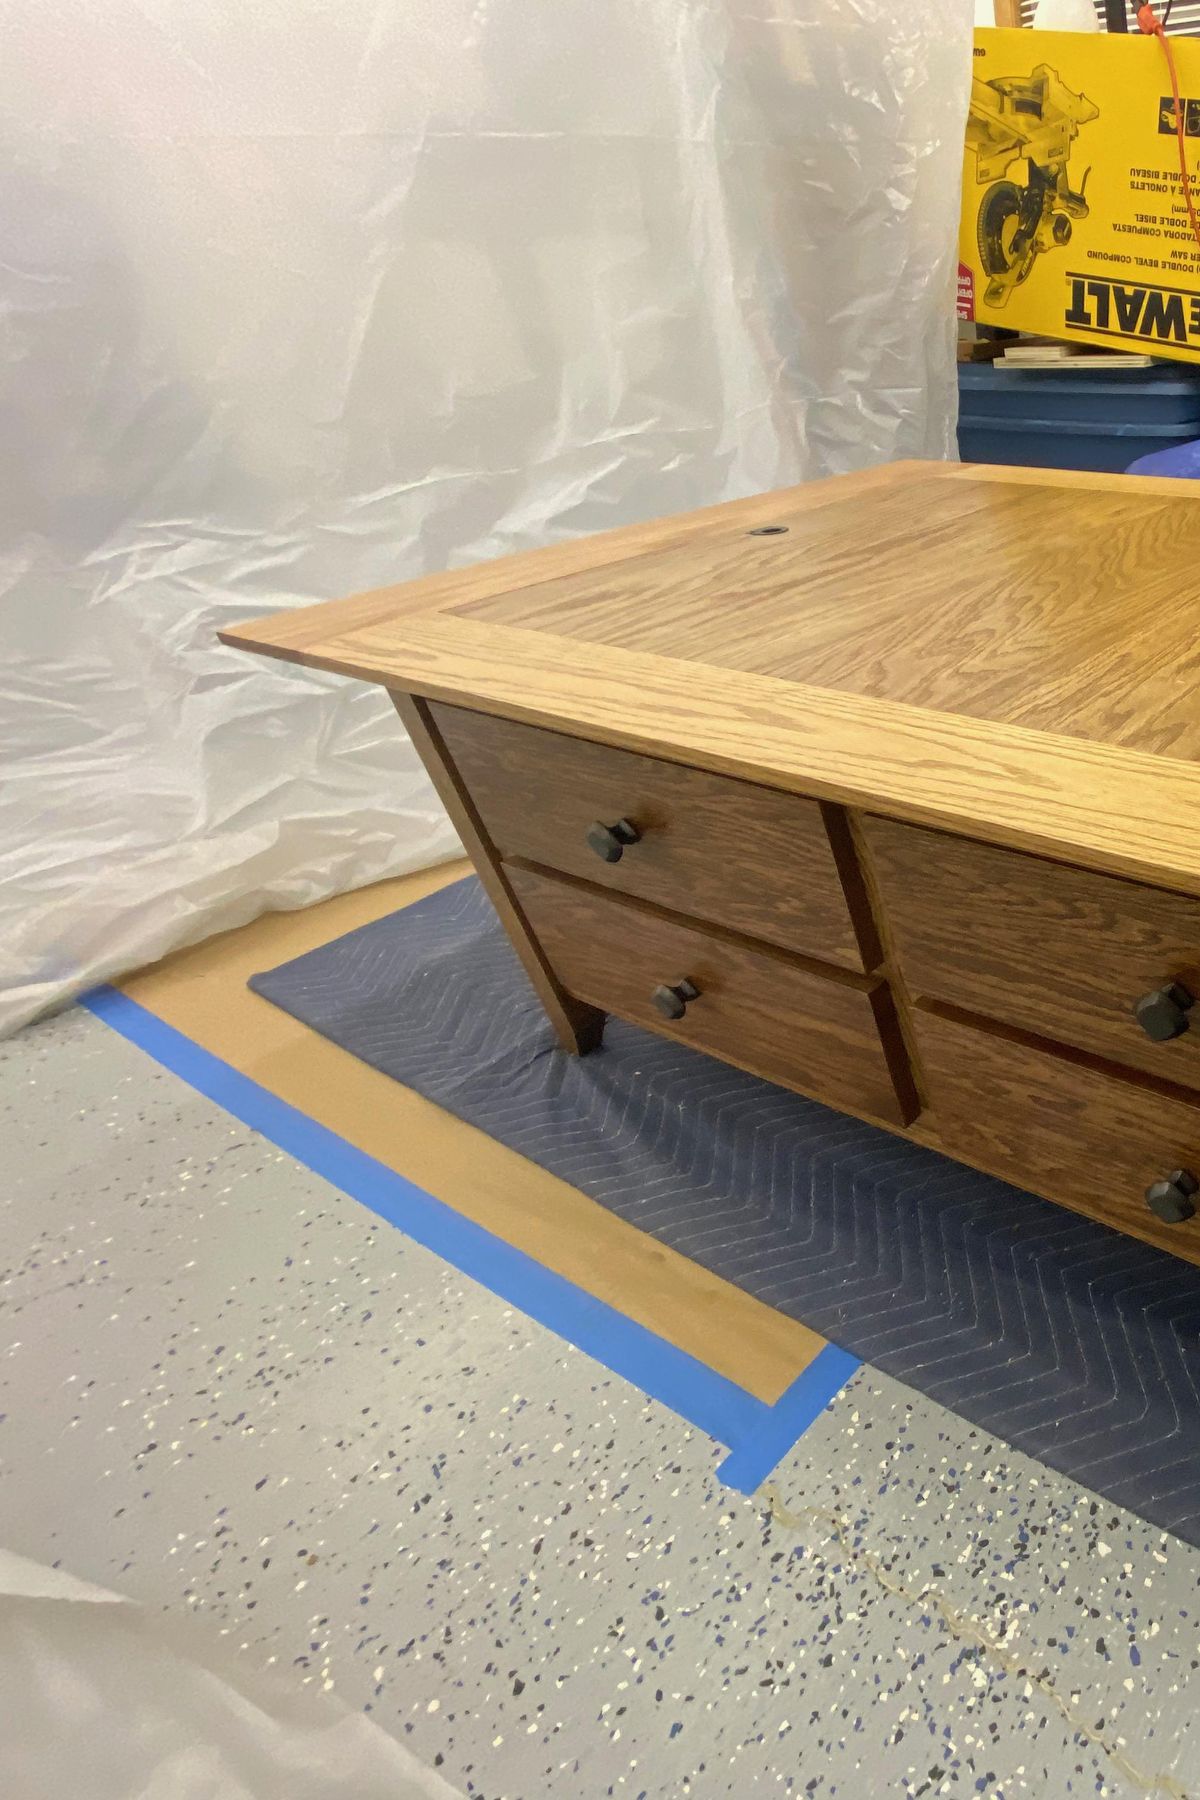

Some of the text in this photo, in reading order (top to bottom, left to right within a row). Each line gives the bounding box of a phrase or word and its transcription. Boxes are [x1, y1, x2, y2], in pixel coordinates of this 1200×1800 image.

[1130, 168, 1160, 179] BISEAU
[1130, 181, 1168, 192] ONGLETS
[1172, 204, 1188, 214] mm)
[1134, 214, 1157, 224] BISEL
[1160, 217, 1187, 228] DOBLE
[1112, 223, 1161, 237] COMPUESTA
[1087, 250, 1131, 263] COMPOUND
[1170, 250, 1188, 260] SAW
[1134, 257, 1158, 268] BEVEL
[1161, 261, 1193, 273] DOUBLE
